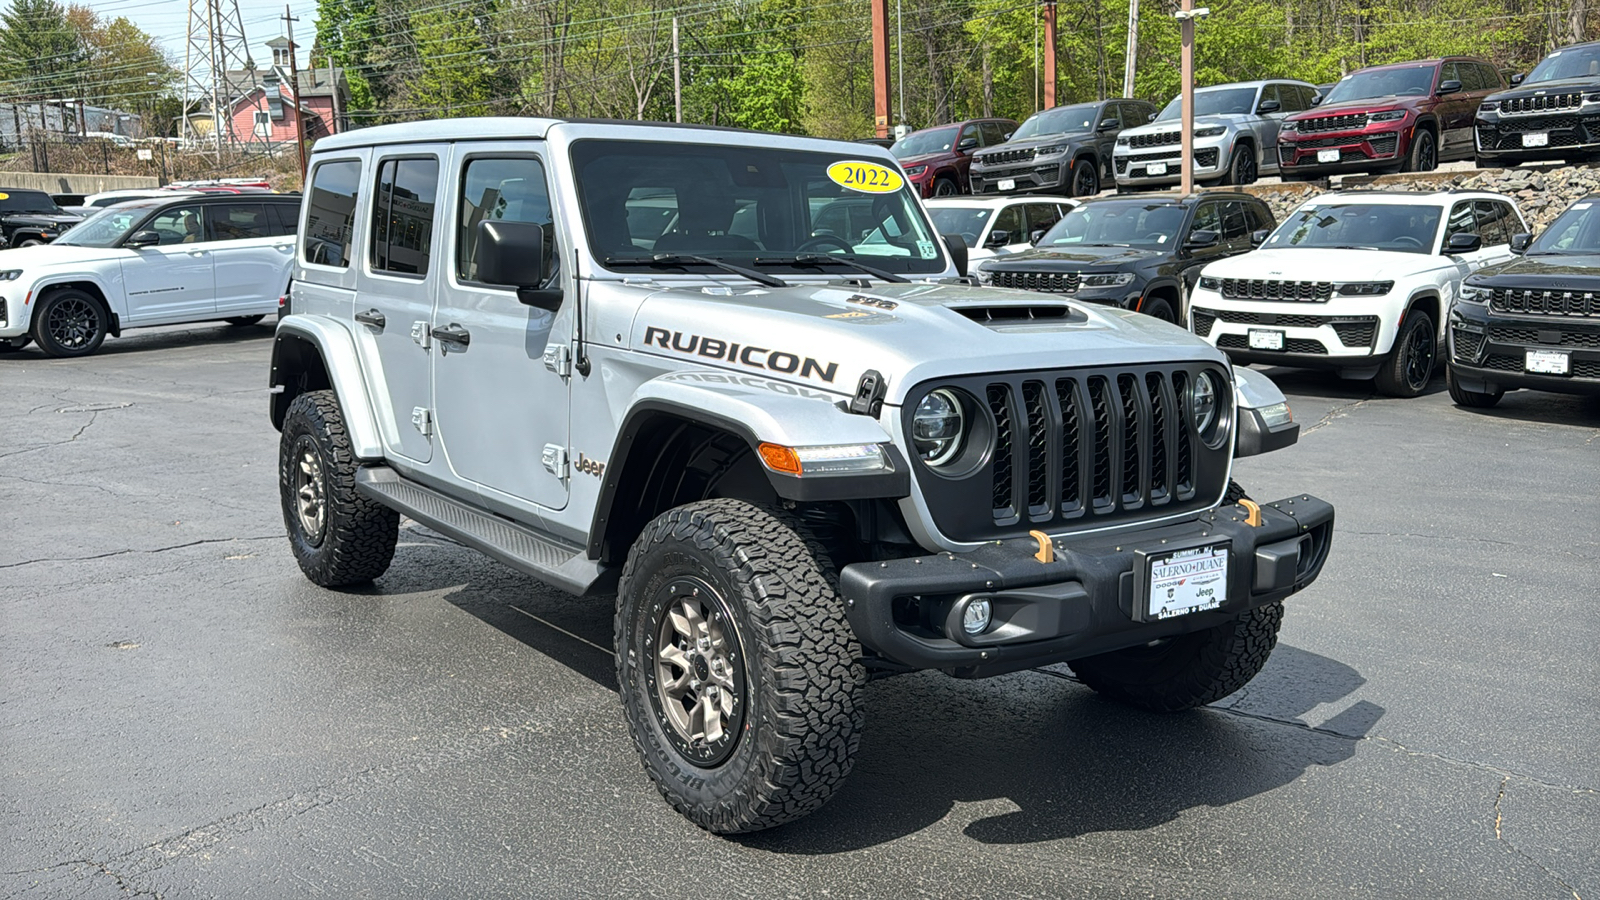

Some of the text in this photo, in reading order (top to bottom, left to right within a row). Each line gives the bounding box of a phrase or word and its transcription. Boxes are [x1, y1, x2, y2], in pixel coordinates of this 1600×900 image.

[844, 167, 890, 187] 2022
[644, 326, 839, 383] RUBICON
[574, 452, 605, 481] Jeep
[1153, 557, 1225, 580] SALERNO DUANE
[1196, 588, 1214, 598] Jeep
[1158, 602, 1220, 619] SALERNO DUANE
